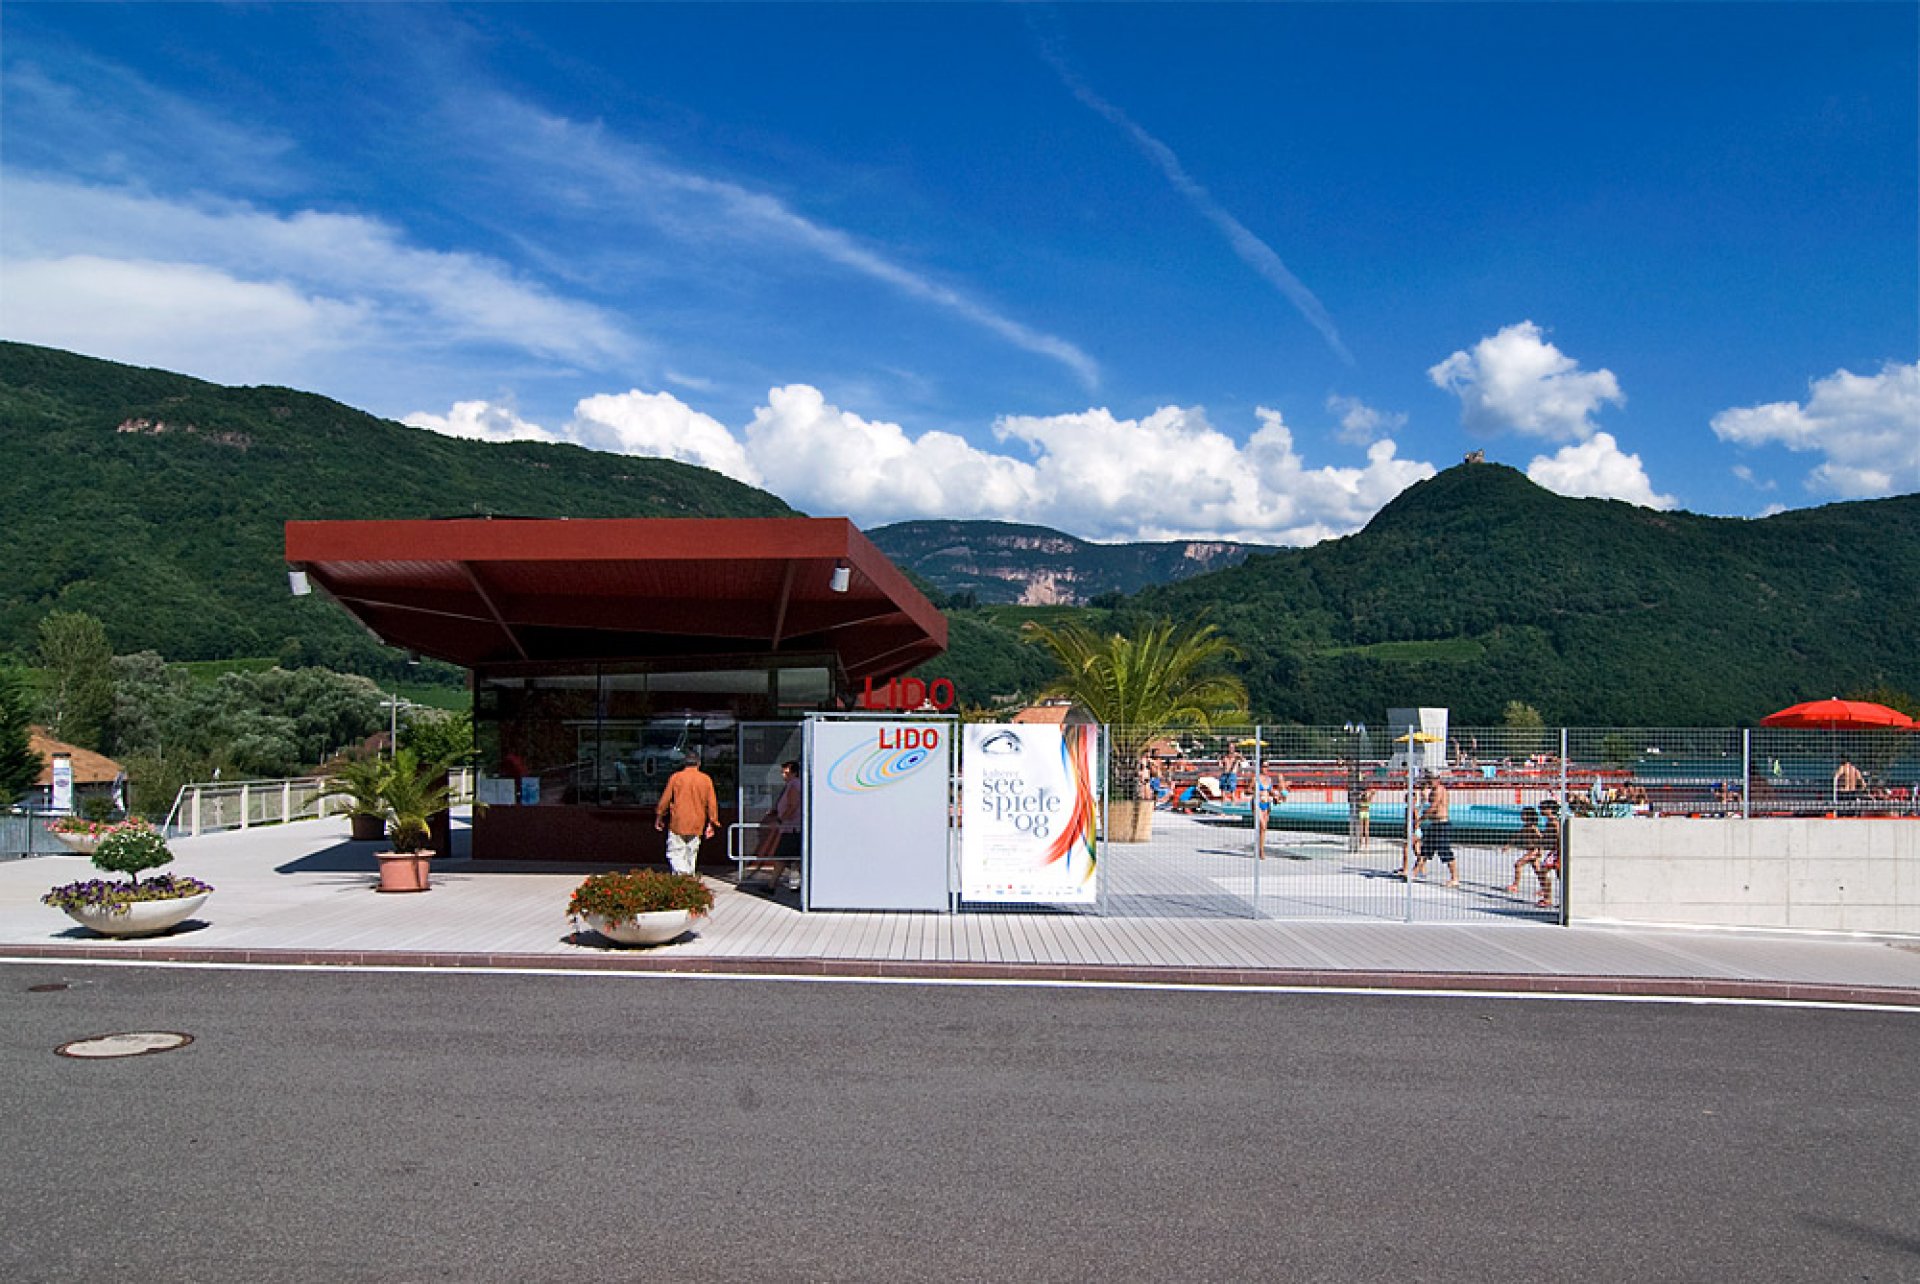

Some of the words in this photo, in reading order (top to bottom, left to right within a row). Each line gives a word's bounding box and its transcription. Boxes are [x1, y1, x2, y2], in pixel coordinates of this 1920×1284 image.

[864, 674, 954, 710] LIDO
[879, 727, 938, 750] LIDO
[982, 779, 1024, 795] see
[982, 788, 1060, 821] spiele
